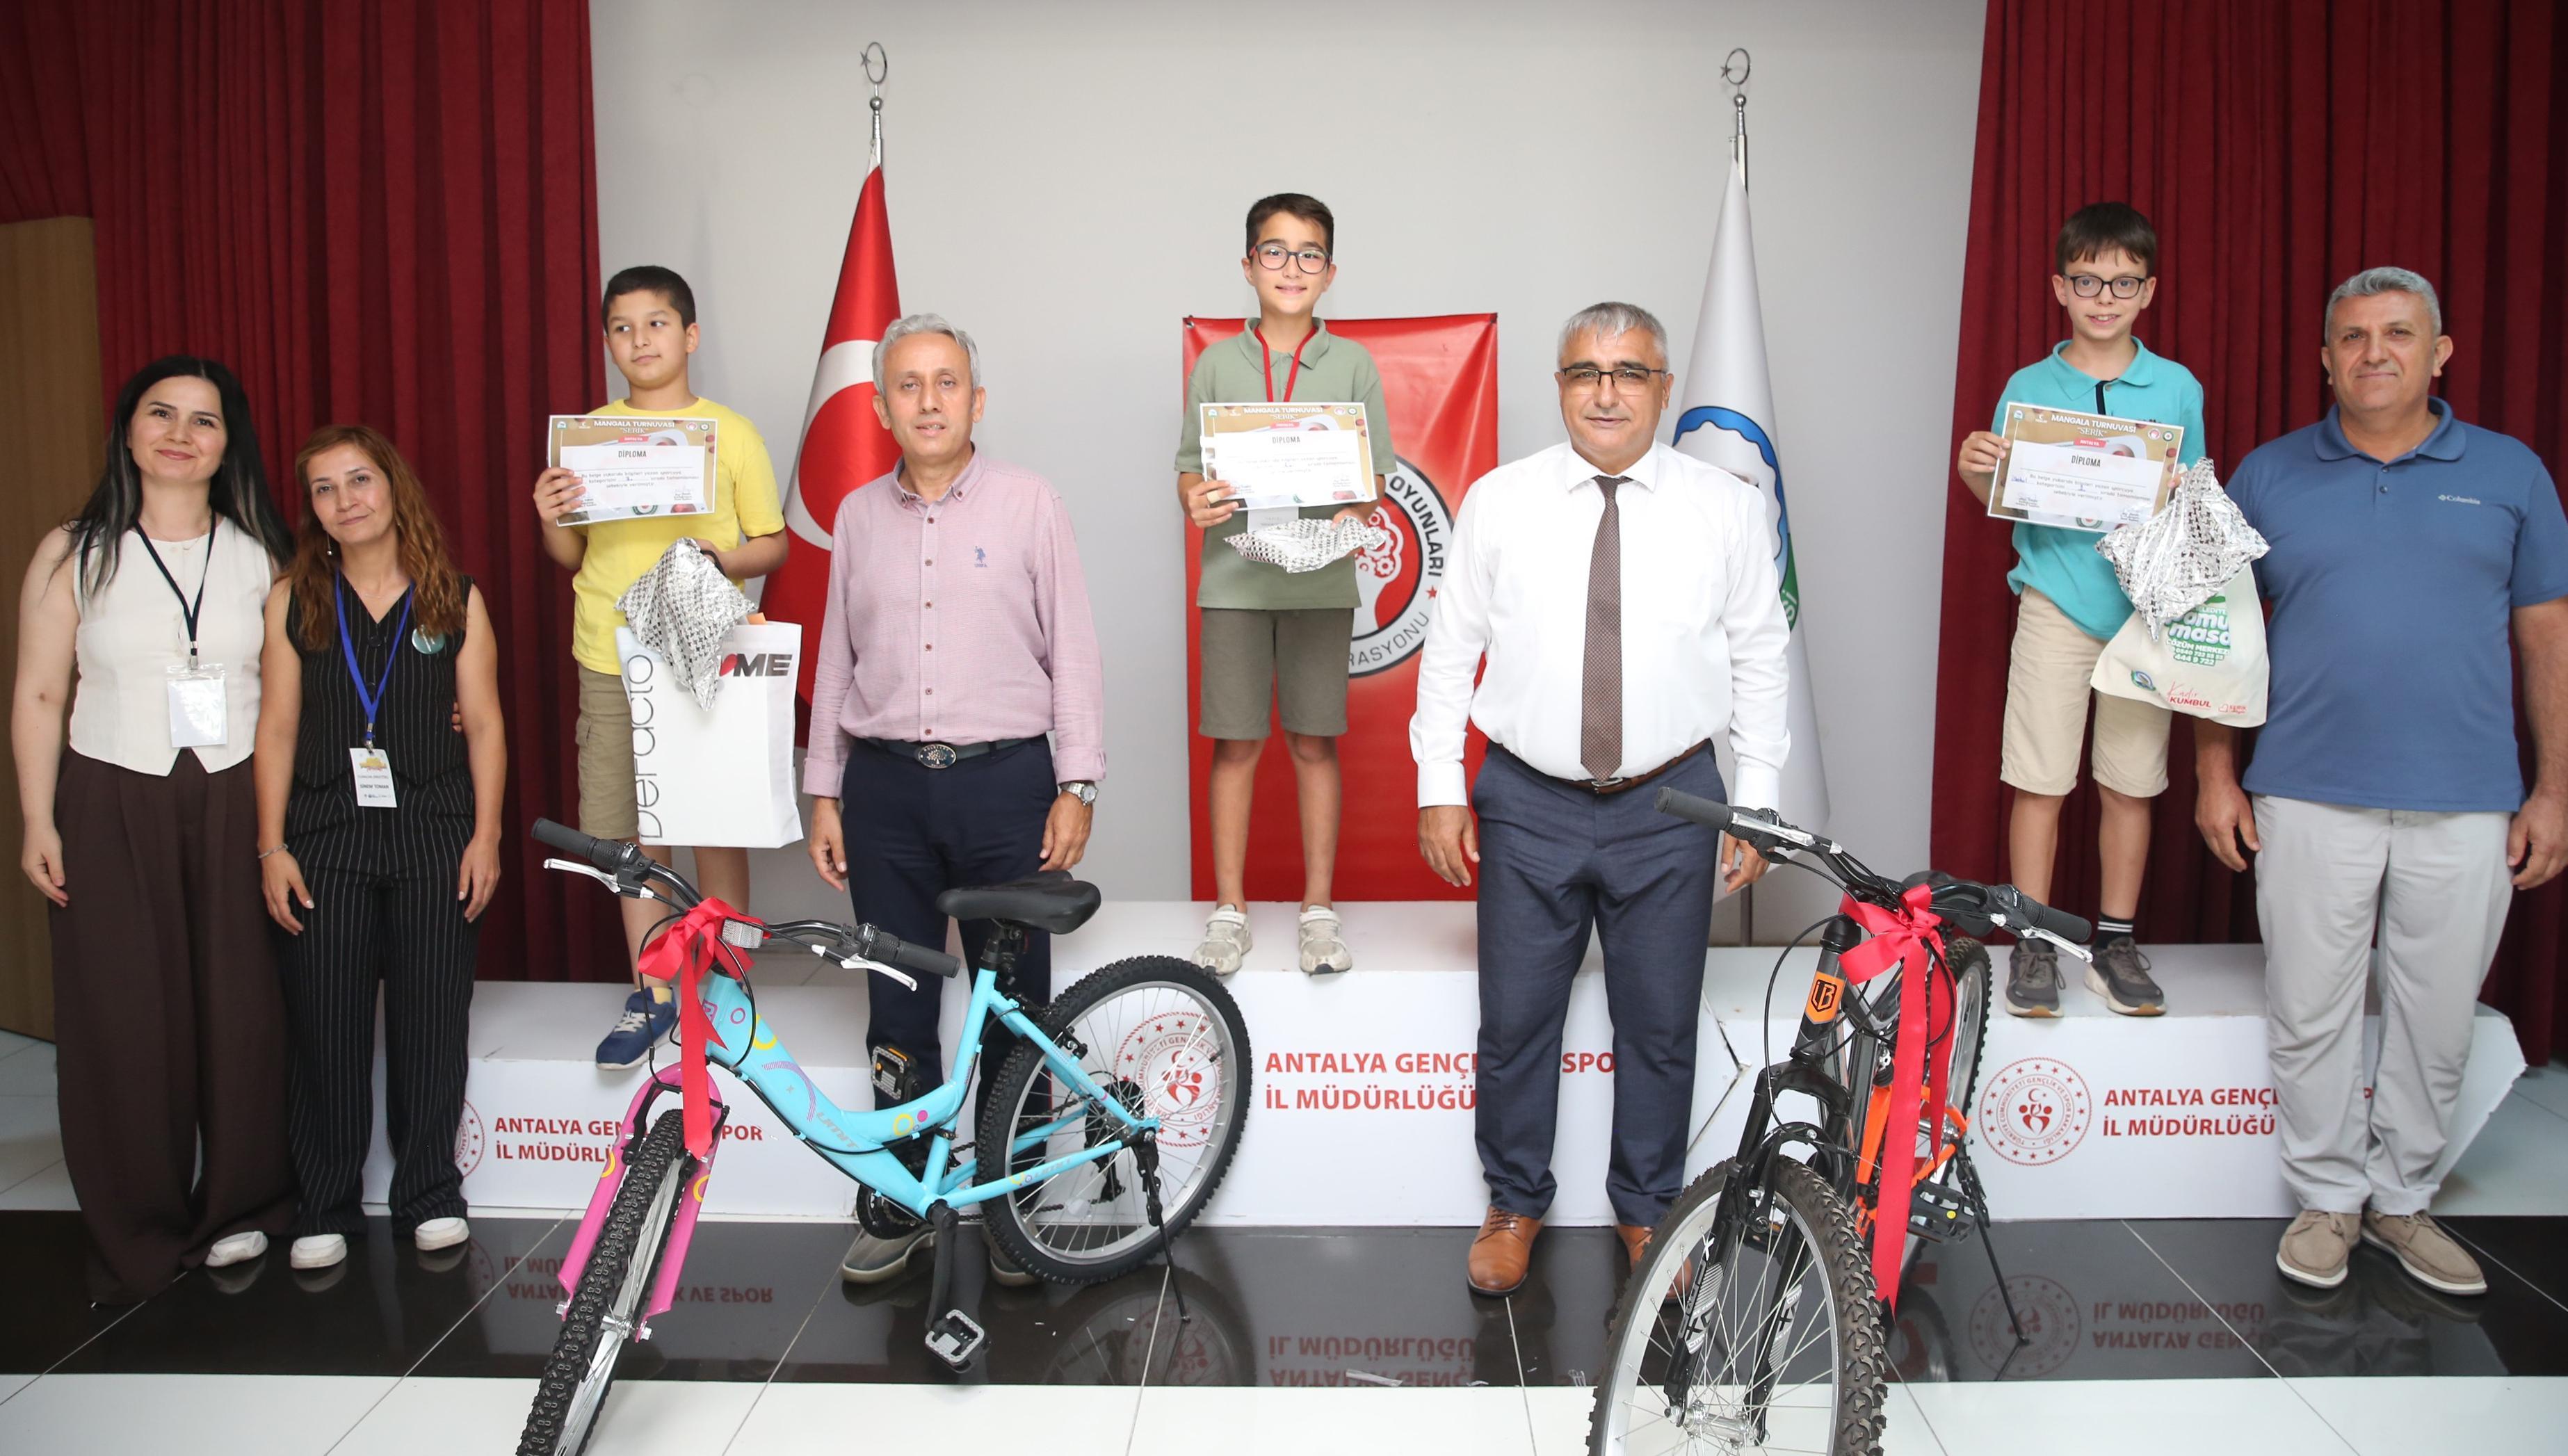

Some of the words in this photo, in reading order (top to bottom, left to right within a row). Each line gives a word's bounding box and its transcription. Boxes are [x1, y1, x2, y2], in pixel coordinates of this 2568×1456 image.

[2051, 414, 2090, 427] MANGALA
[2092, 419, 2136, 434] TURNUVASI
[618, 450, 647, 458] DİPLOMA
[2072, 455, 2101, 467] DİPLOMA
[1389, 476, 1444, 577] OYUNLARI
[2170, 696, 2211, 708] KUMBUL
[1265, 1053, 1387, 1073] ANTALYA
[1562, 1052, 1616, 1073] SPO
[2026, 1078, 2056, 1087] GENÇLİK
[1266, 1084, 1289, 1109] İL
[1296, 1084, 1476, 1110] MÜDÜRLÜĞÜ
[2104, 1088, 2204, 1106] ANTALYA
[494, 1117, 583, 1135] ANTALYA
[722, 1124, 763, 1140] POR
[2103, 1115, 2122, 1136] İL
[2128, 1114, 2275, 1136] MÜDÜRLÜĞÜ
[496, 1140, 513, 1159] İL
